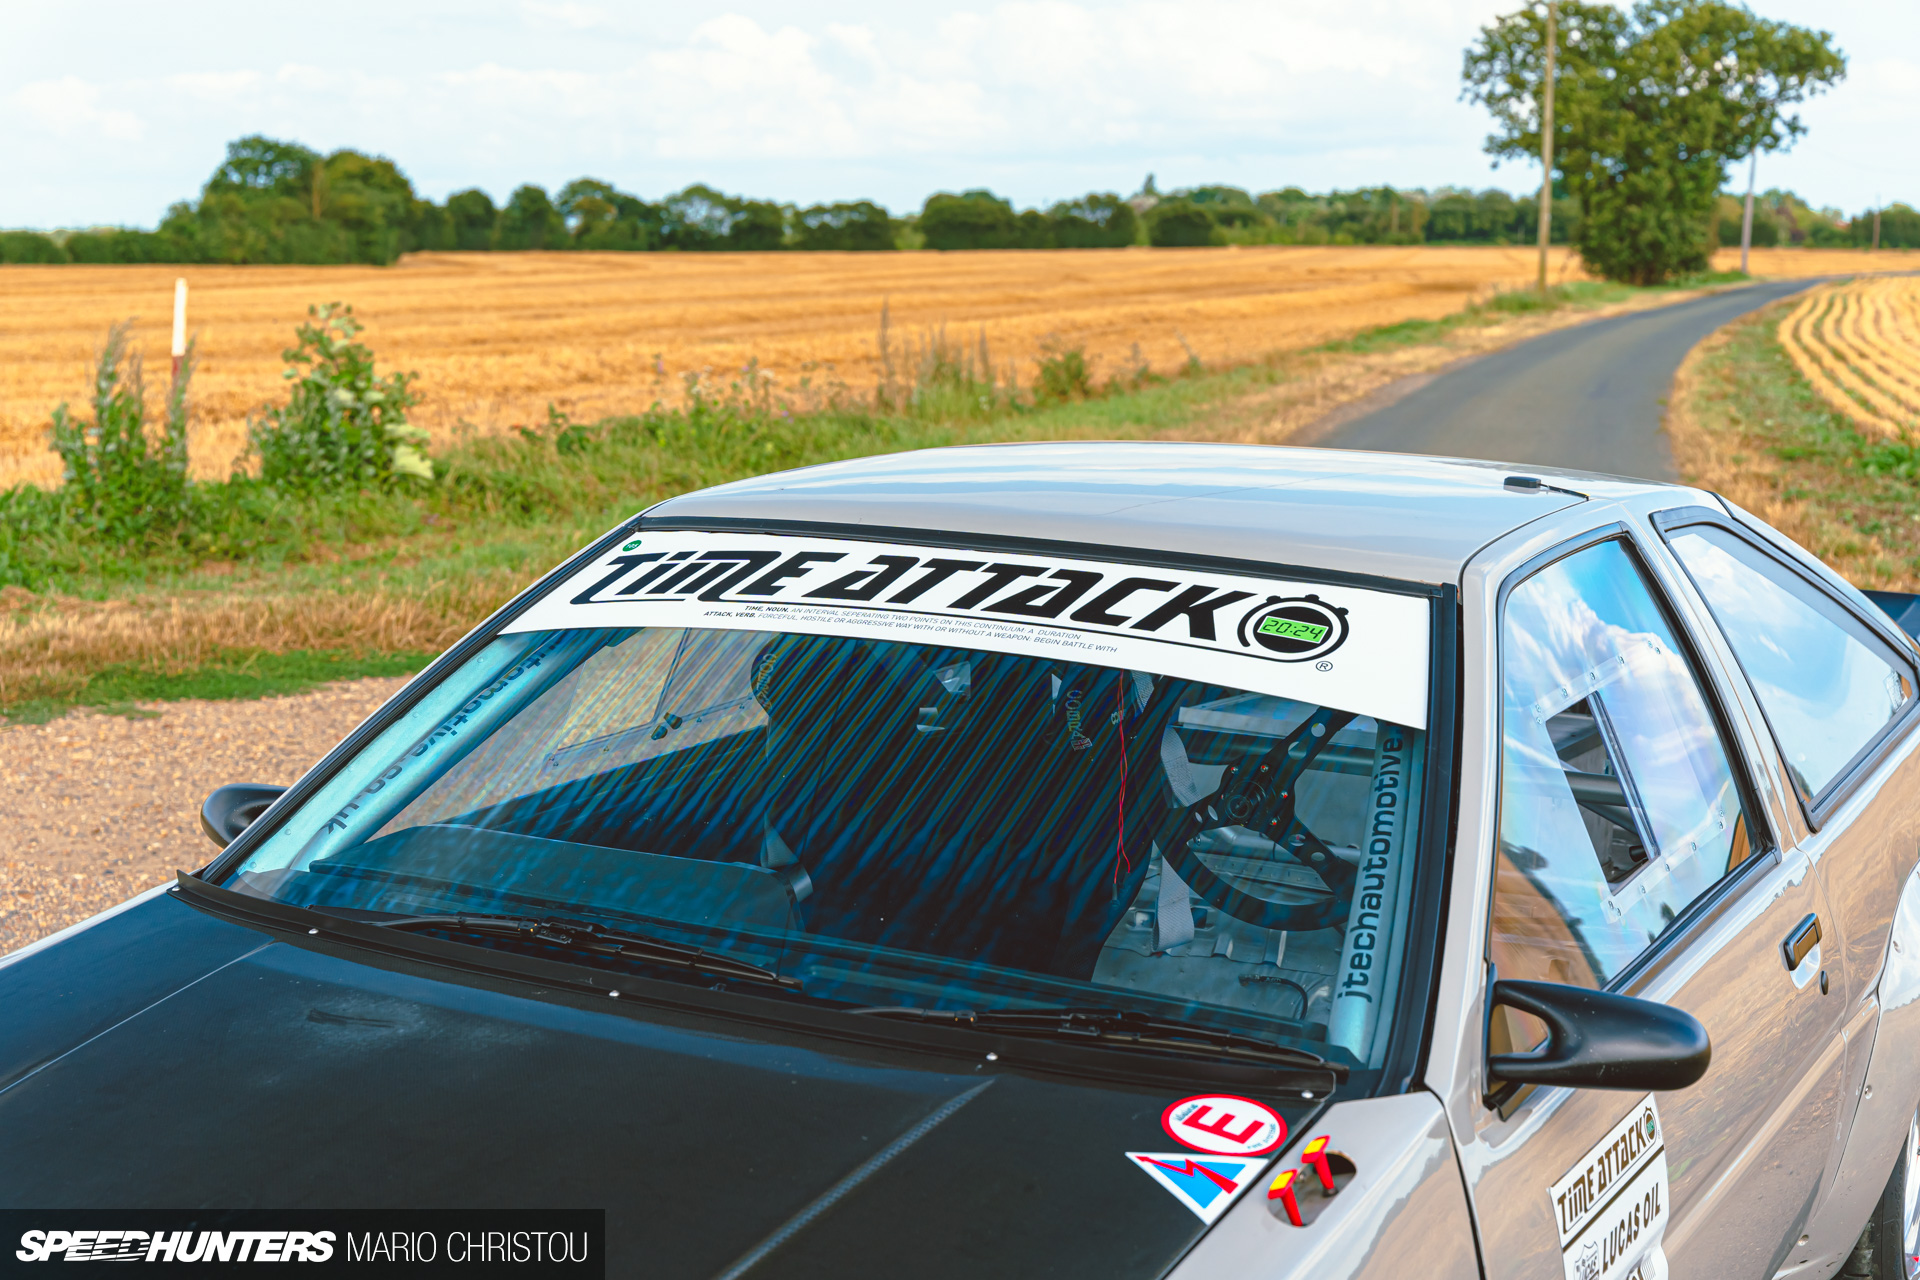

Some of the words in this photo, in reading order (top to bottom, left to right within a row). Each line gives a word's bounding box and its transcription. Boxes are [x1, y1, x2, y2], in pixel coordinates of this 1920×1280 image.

[800, 615, 832, 623] HOSTILE
[846, 618, 893, 628] AGGRESSIVE
[948, 627, 985, 637] WITHOUT
[1034, 636, 1061, 645] BEGIN
[1062, 640, 1094, 650] BATTLE
[1095, 645, 1118, 653] WITH
[803, 608, 839, 616] INTERVAL
[841, 610, 889, 620] SEPERATING
[909, 616, 939, 625] POINTS
[954, 619, 972, 628] THIS
[1037, 629, 1082, 640] DURATION
[1262, 619, 1324, 640] 20:24
[1181, 1105, 1265, 1145] E
[1602, 1202, 1641, 1275] LUCAS
[1643, 1182, 1661, 1229] OIL
